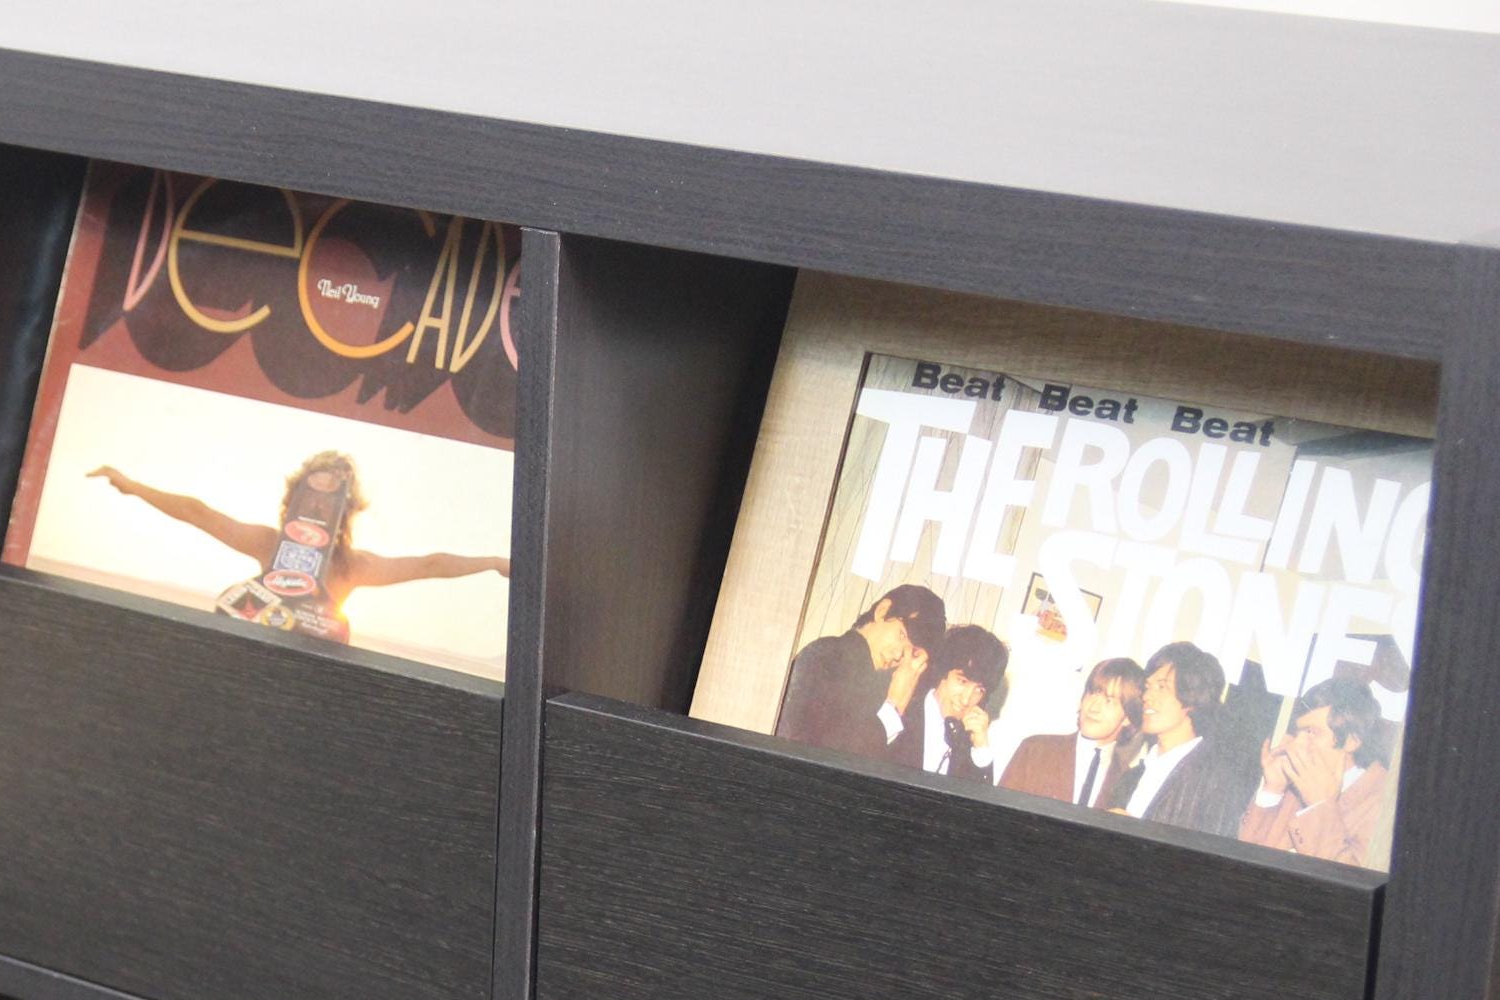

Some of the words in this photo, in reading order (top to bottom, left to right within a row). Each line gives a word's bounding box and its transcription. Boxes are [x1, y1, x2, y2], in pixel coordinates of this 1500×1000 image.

[317, 278, 341, 300] Neil
[342, 283, 381, 309] Young
[911, 362, 1006, 402] Beat
[1038, 383, 1139, 424] Beat
[1170, 405, 1276, 447] Beat
[850, 388, 1060, 590] THE
